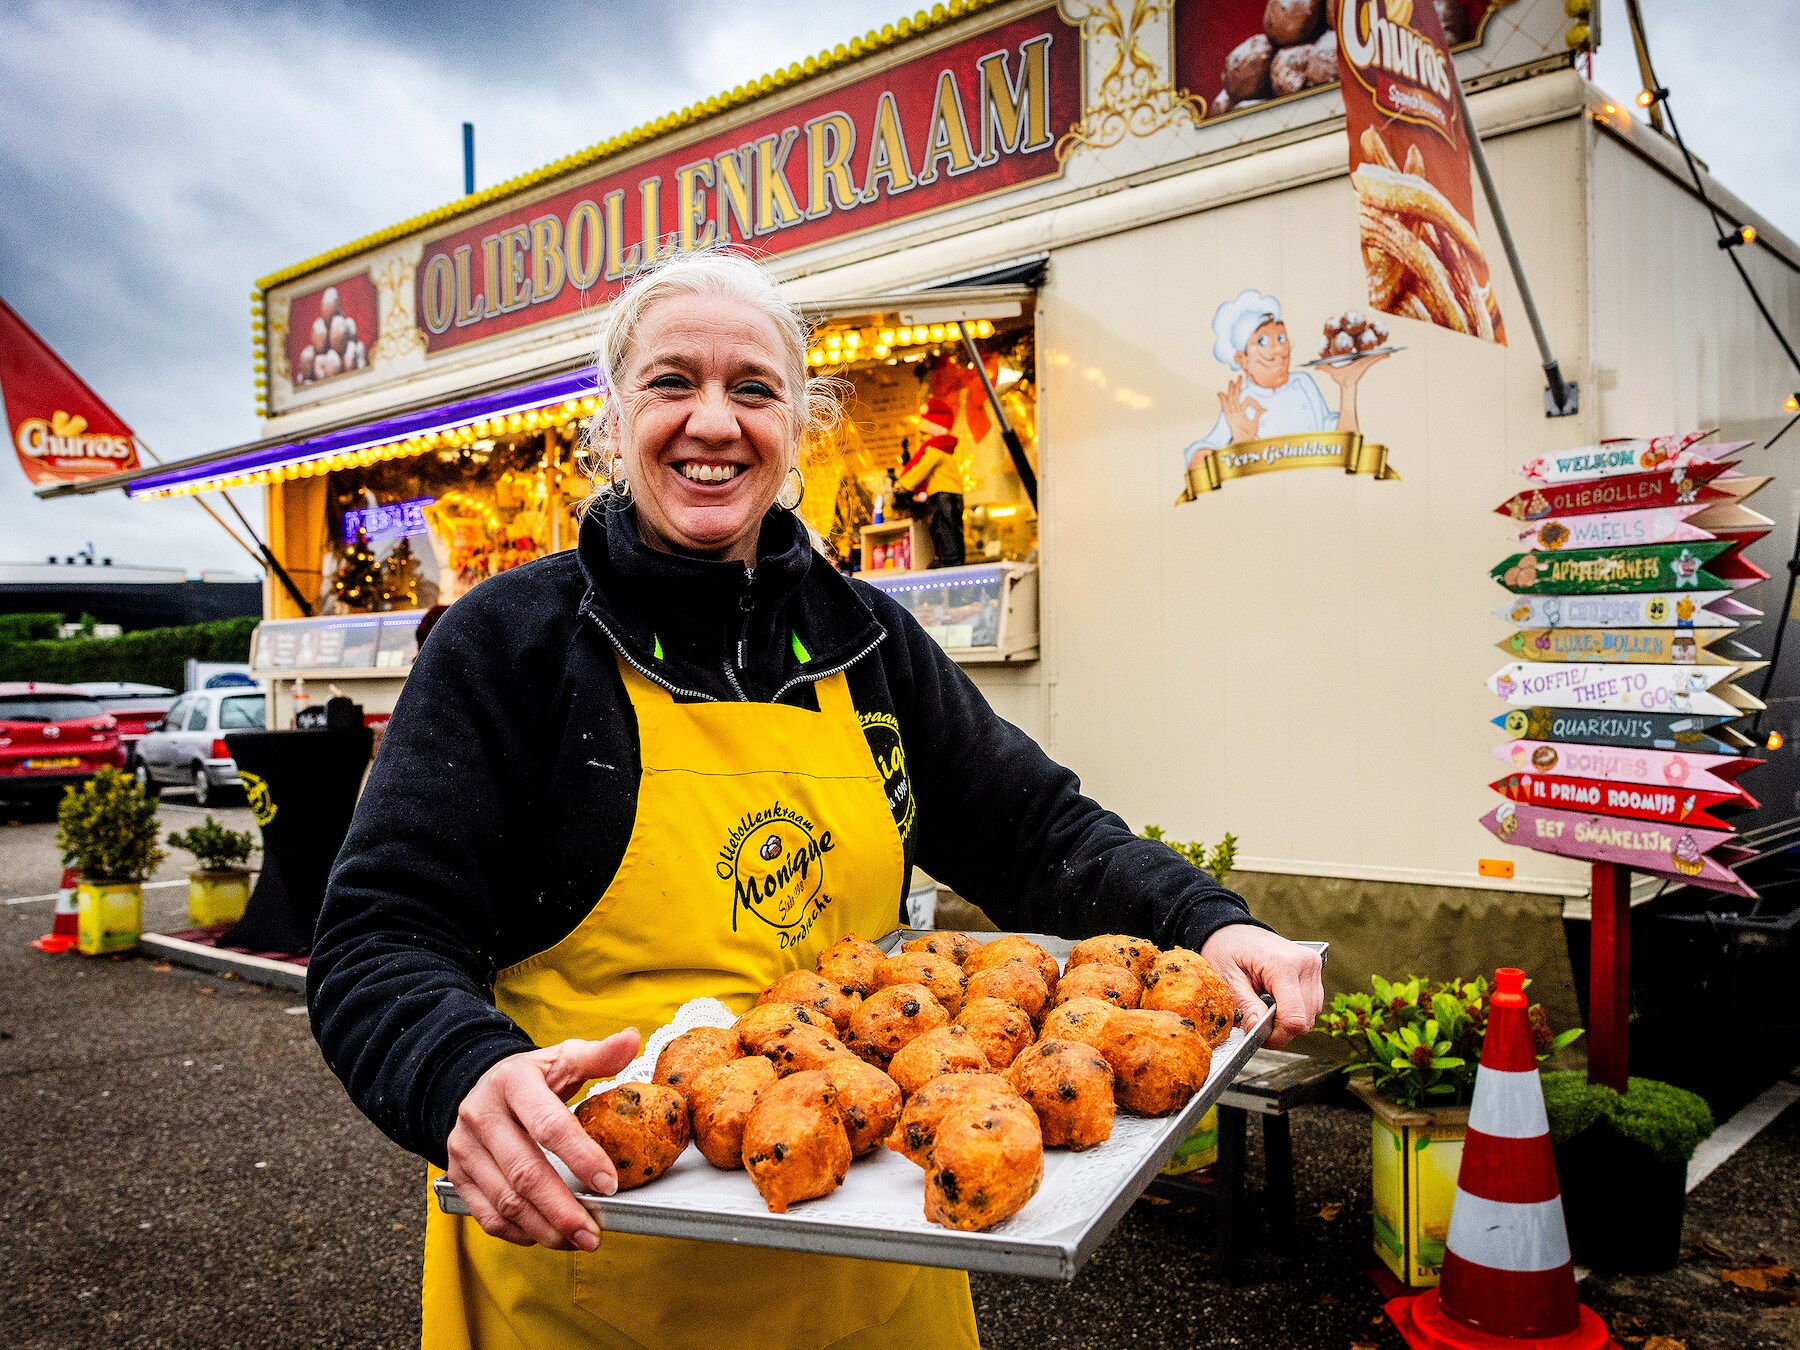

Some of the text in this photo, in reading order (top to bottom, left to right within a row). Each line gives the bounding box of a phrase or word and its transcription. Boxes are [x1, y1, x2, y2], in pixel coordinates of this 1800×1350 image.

[1341, 0, 1451, 100] Churros
[422, 32, 1054, 336] OLIEBOLLENKRAAM
[18, 419, 130, 459] Churros
[1262, 441, 1342, 465] Gebakken
[1556, 450, 1635, 474] WELKOM
[1553, 480, 1663, 509] OLIEBOLLEN
[1573, 521, 1646, 541] WAFELS
[1522, 667, 1588, 695] KOFFIE/
[1573, 673, 1647, 703] THEE TO
[1640, 686, 1669, 709] GO
[1552, 718, 1653, 738] QUARKINI'S
[1533, 781, 1676, 815] IL PRIMO ROOMIJS
[716, 800, 815, 881] Oliebollenkraam
[1535, 818, 1672, 853] EET SMAKELIJK
[732, 830, 836, 933] Monique
[776, 893, 832, 950] Dordrecht
